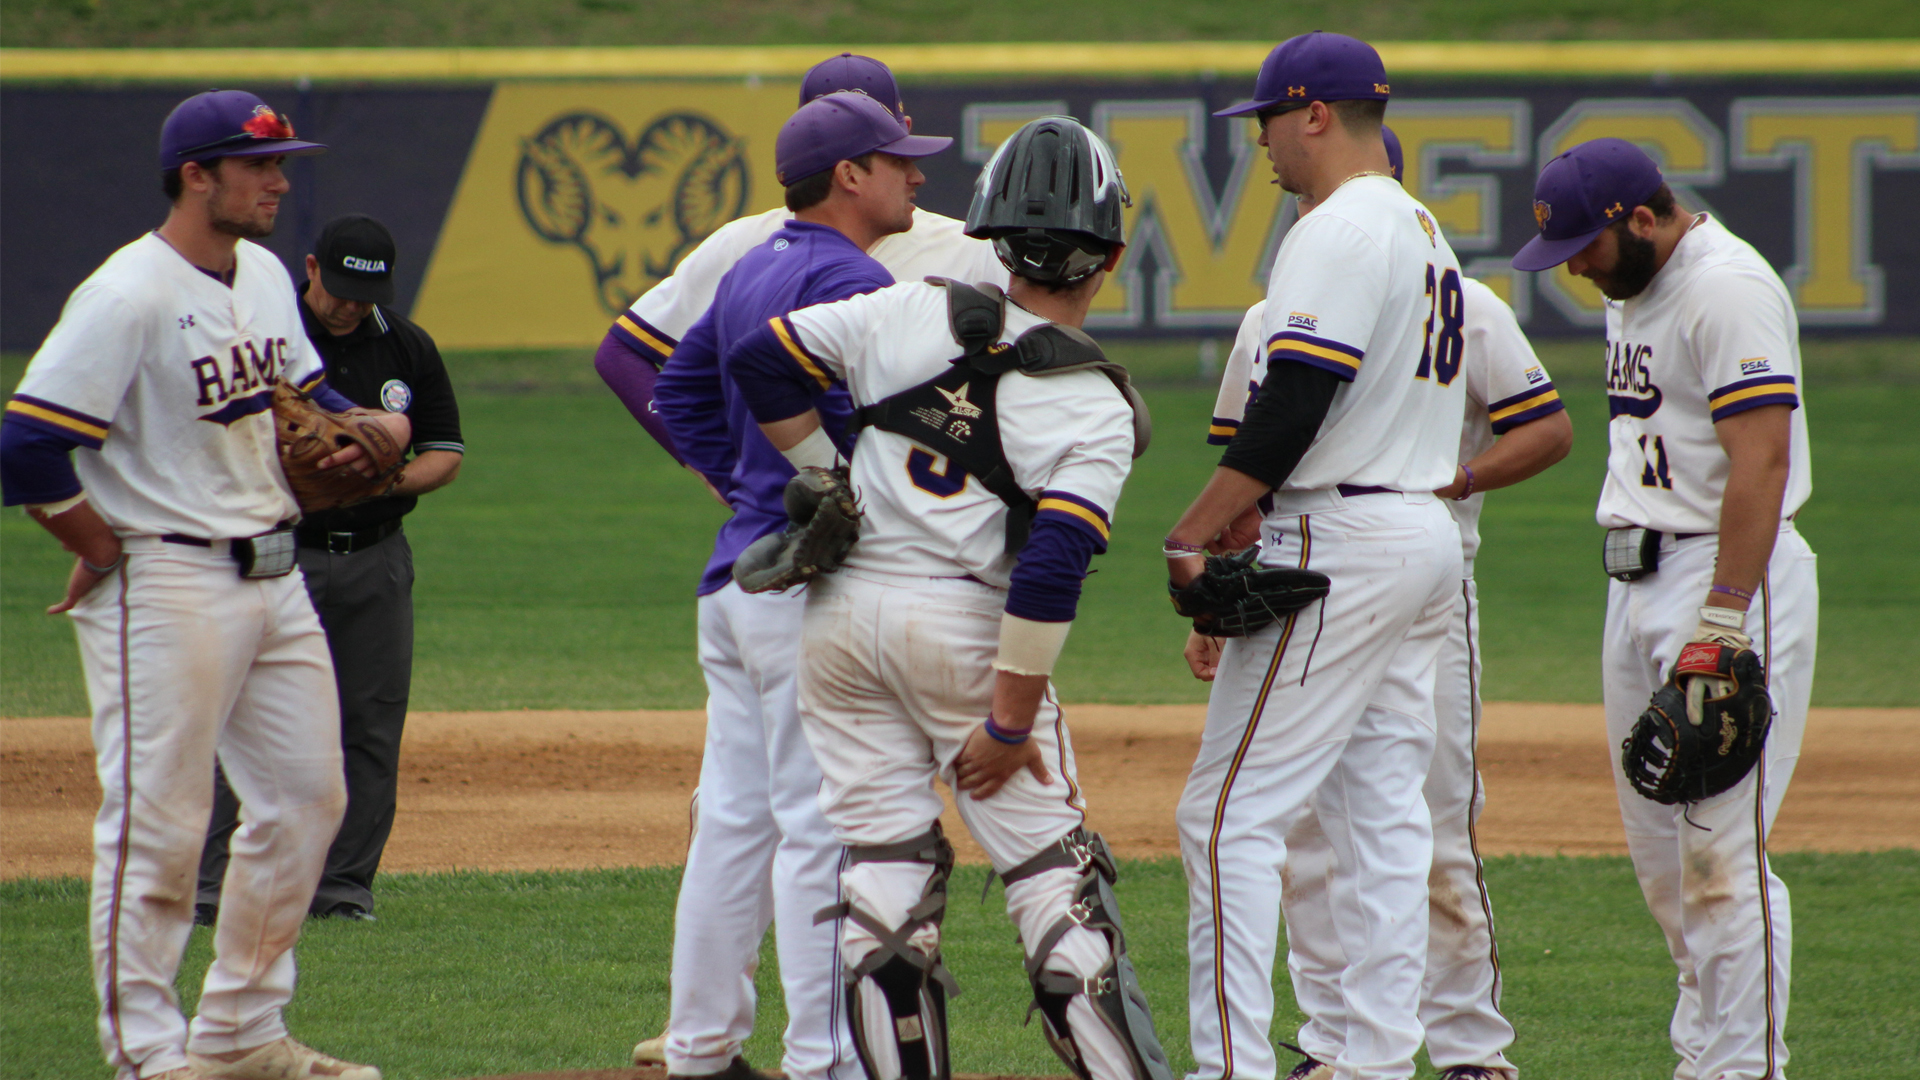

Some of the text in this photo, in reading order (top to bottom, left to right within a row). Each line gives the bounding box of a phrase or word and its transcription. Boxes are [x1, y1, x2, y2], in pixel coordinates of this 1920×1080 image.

[343, 255, 387, 273] CBUA
[1287, 315, 1318, 328] PSAC
[1413, 261, 1465, 388] 28
[1740, 359, 1770, 371] PSAC
[1638, 433, 1674, 491] 11
[1718, 711, 1739, 756] Rawlings
